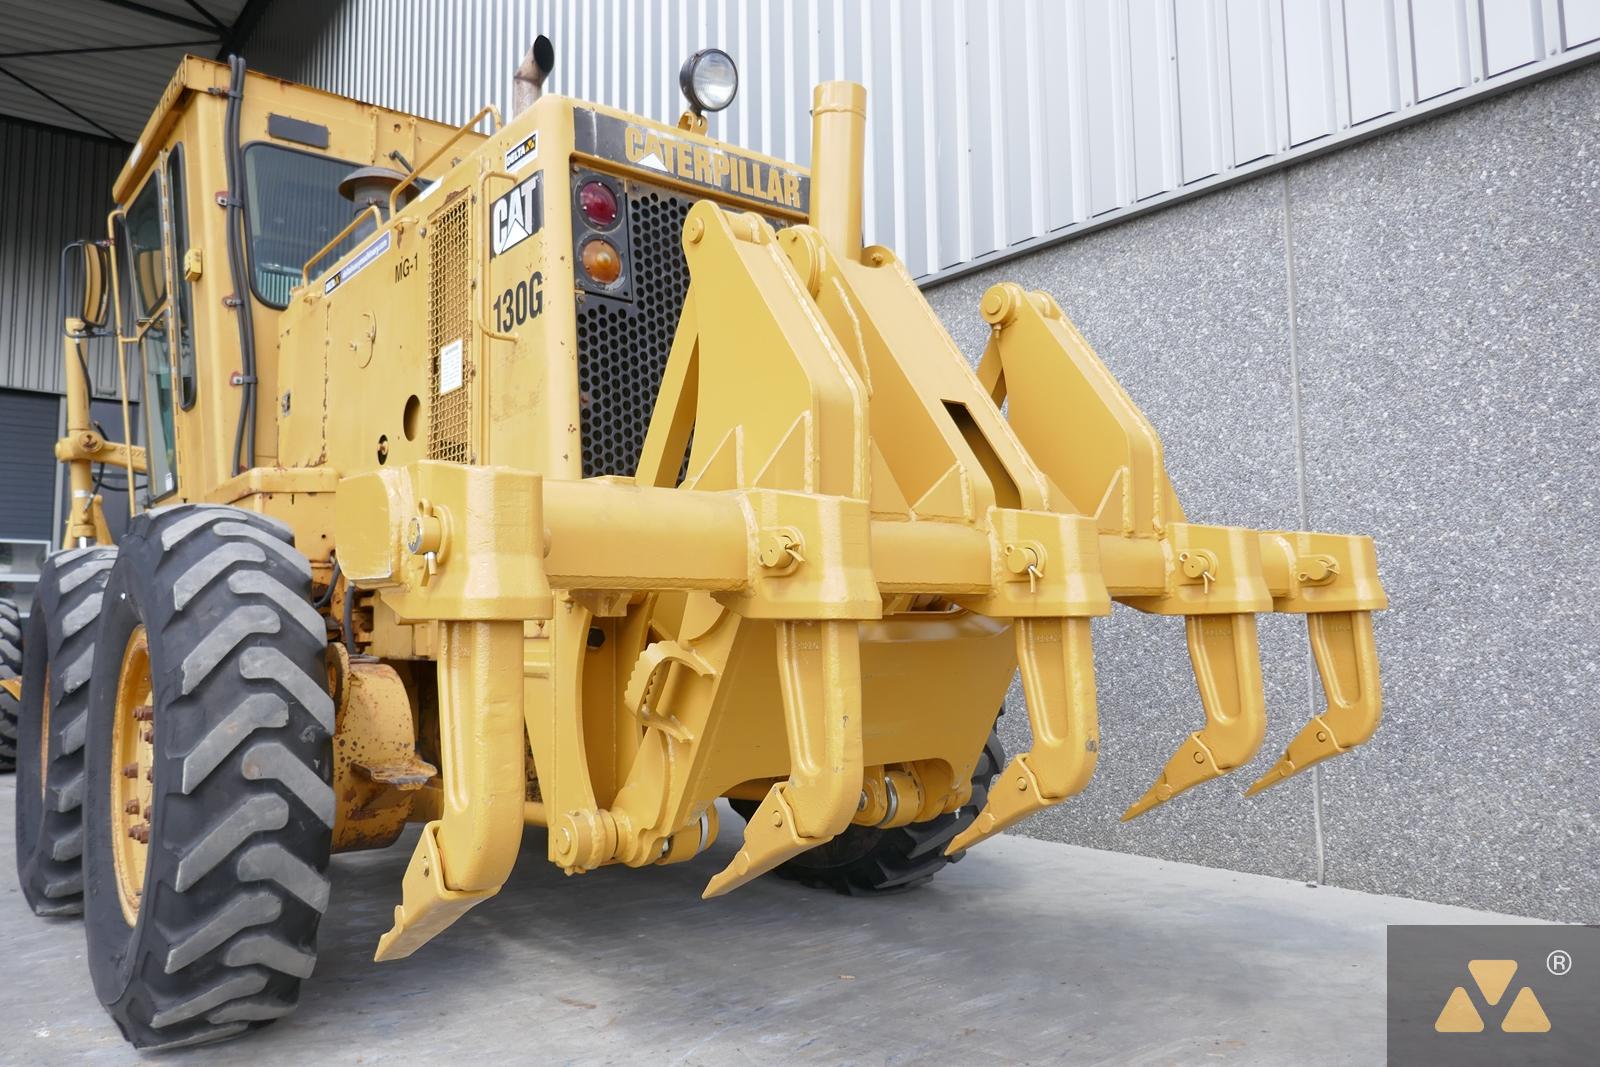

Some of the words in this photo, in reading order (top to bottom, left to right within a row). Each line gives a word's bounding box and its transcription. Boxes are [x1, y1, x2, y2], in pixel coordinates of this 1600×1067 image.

[625, 127, 801, 209] CATERPILLAR
[493, 175, 538, 255] CAT
[395, 252, 418, 283] MG-1
[493, 270, 543, 333] 130G
